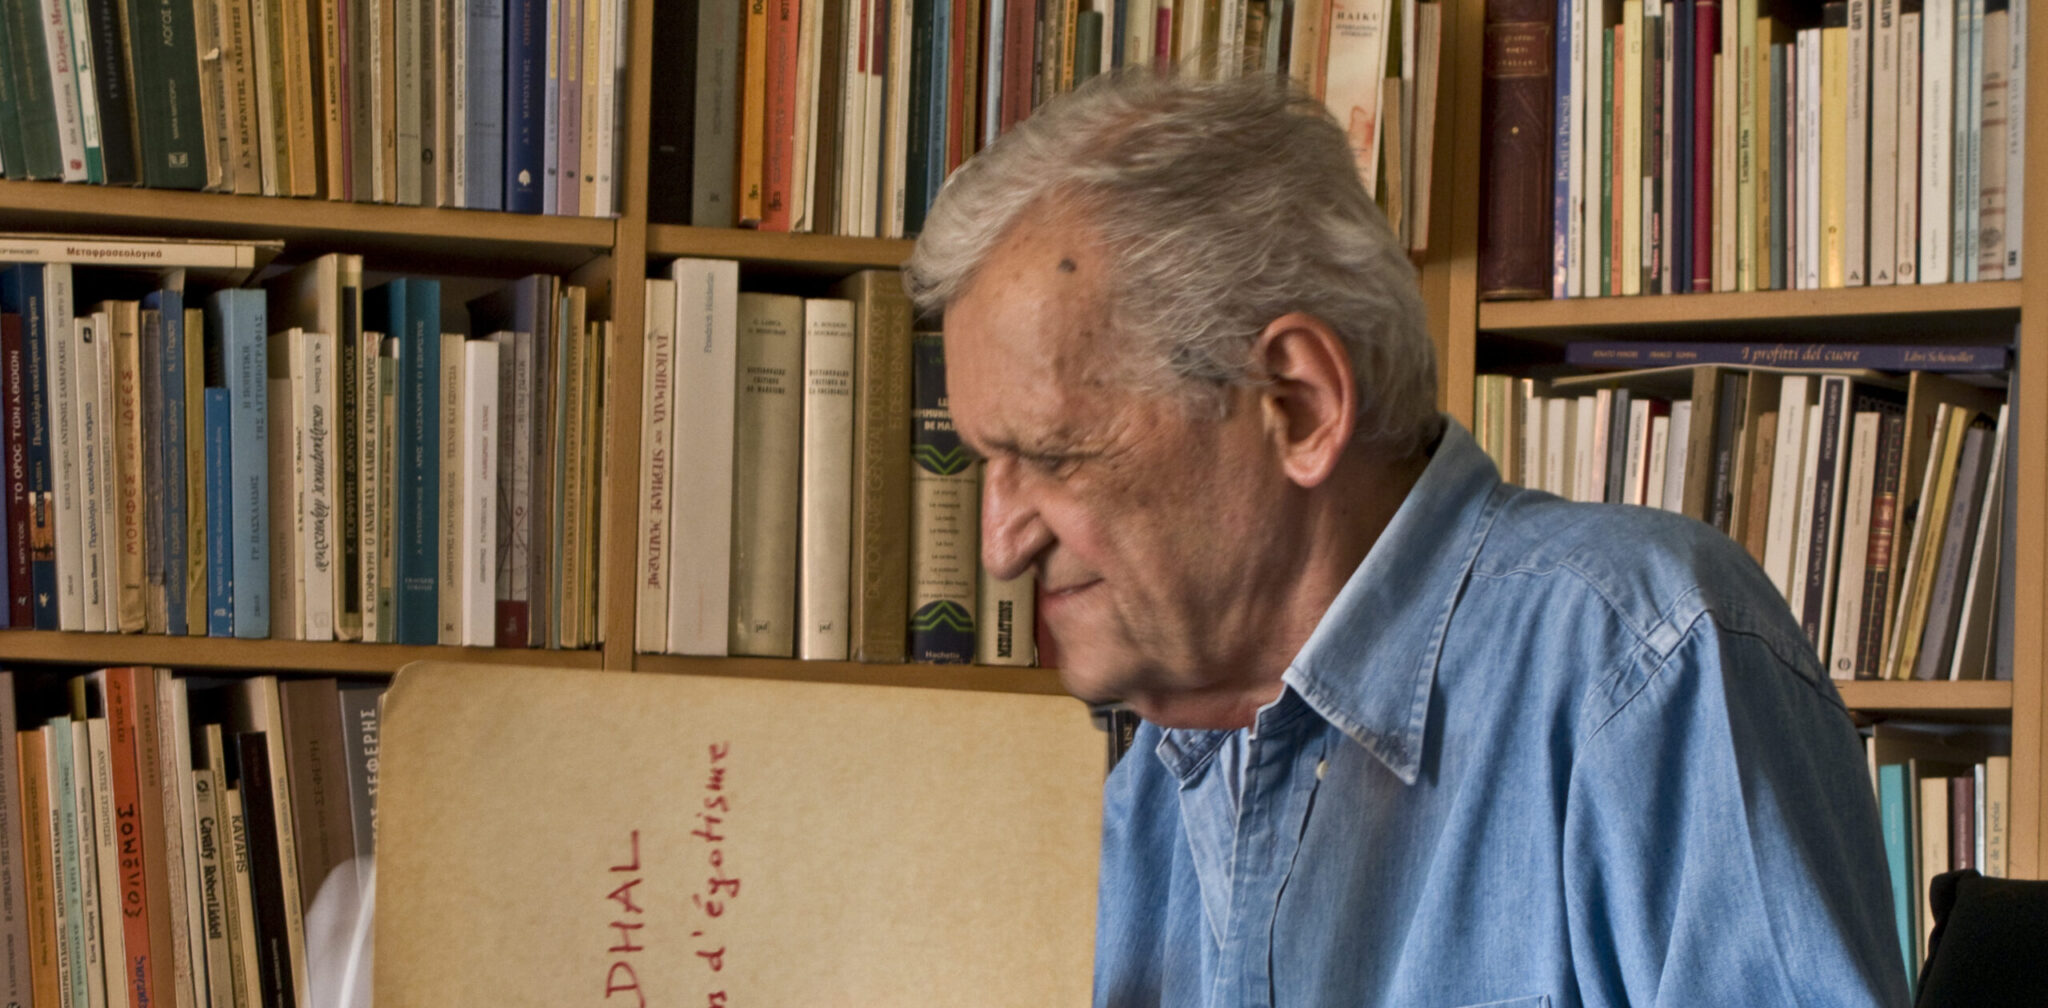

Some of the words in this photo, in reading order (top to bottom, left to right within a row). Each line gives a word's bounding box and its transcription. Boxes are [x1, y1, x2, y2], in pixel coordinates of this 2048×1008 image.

[1851, 1, 1863, 31] GATTO
[57, 339, 68, 399] ΣΑΜΑΡΑΚΗΣ
[1752, 344, 1799, 364] profitti
[1802, 344, 1824, 361] del
[1824, 350, 1860, 362] cuore
[747, 366, 785, 376] DICTIONNAIRE
[809, 369, 849, 378] DICTIONNAIRE
[58, 401, 69, 447] ΑΝΤΩΝΗΣ
[1816, 515, 1826, 543] DELLA
[1813, 545, 1823, 572] VALLE
[360, 708, 379, 797] ΣΕΦΕΡΗΣ
[309, 739, 325, 807] ΣΕΦΕΡΗ
[1989, 800, 2002, 832] poésie
[199, 815, 216, 862] Cavafy
[231, 814, 248, 874] KAVAFIS
[1989, 836, 2000, 845] la
[1989, 848, 2001, 861] de
[203, 864, 219, 903] Robert
[207, 902, 223, 941] Liddell
